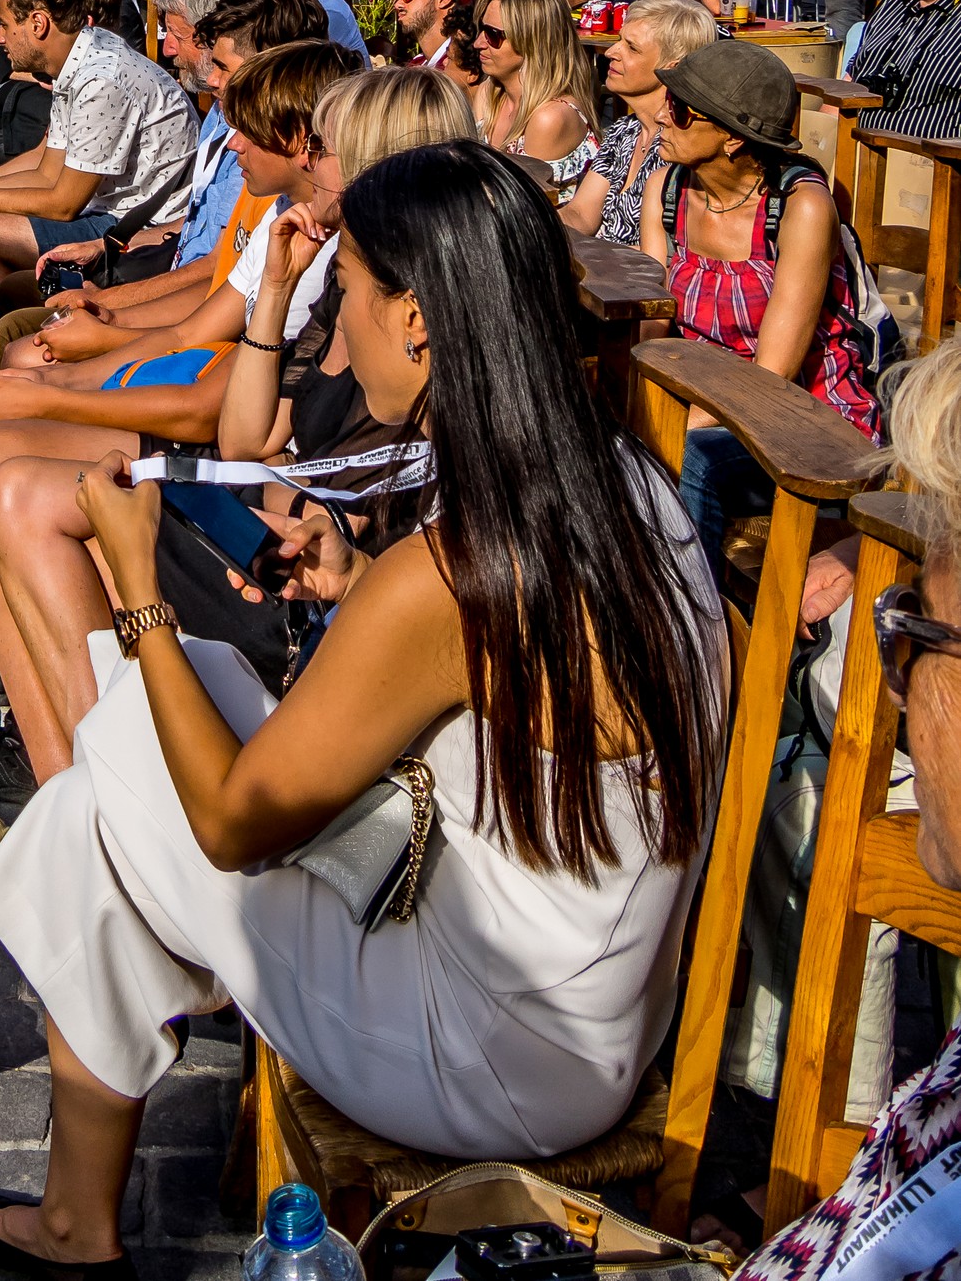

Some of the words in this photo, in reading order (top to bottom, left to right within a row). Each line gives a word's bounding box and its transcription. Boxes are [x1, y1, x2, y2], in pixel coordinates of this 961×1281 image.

[288, 460, 332, 470] HAINAUT
[299, 465, 332, 473] Province
[836, 1198, 905, 1274] HAINAUT
